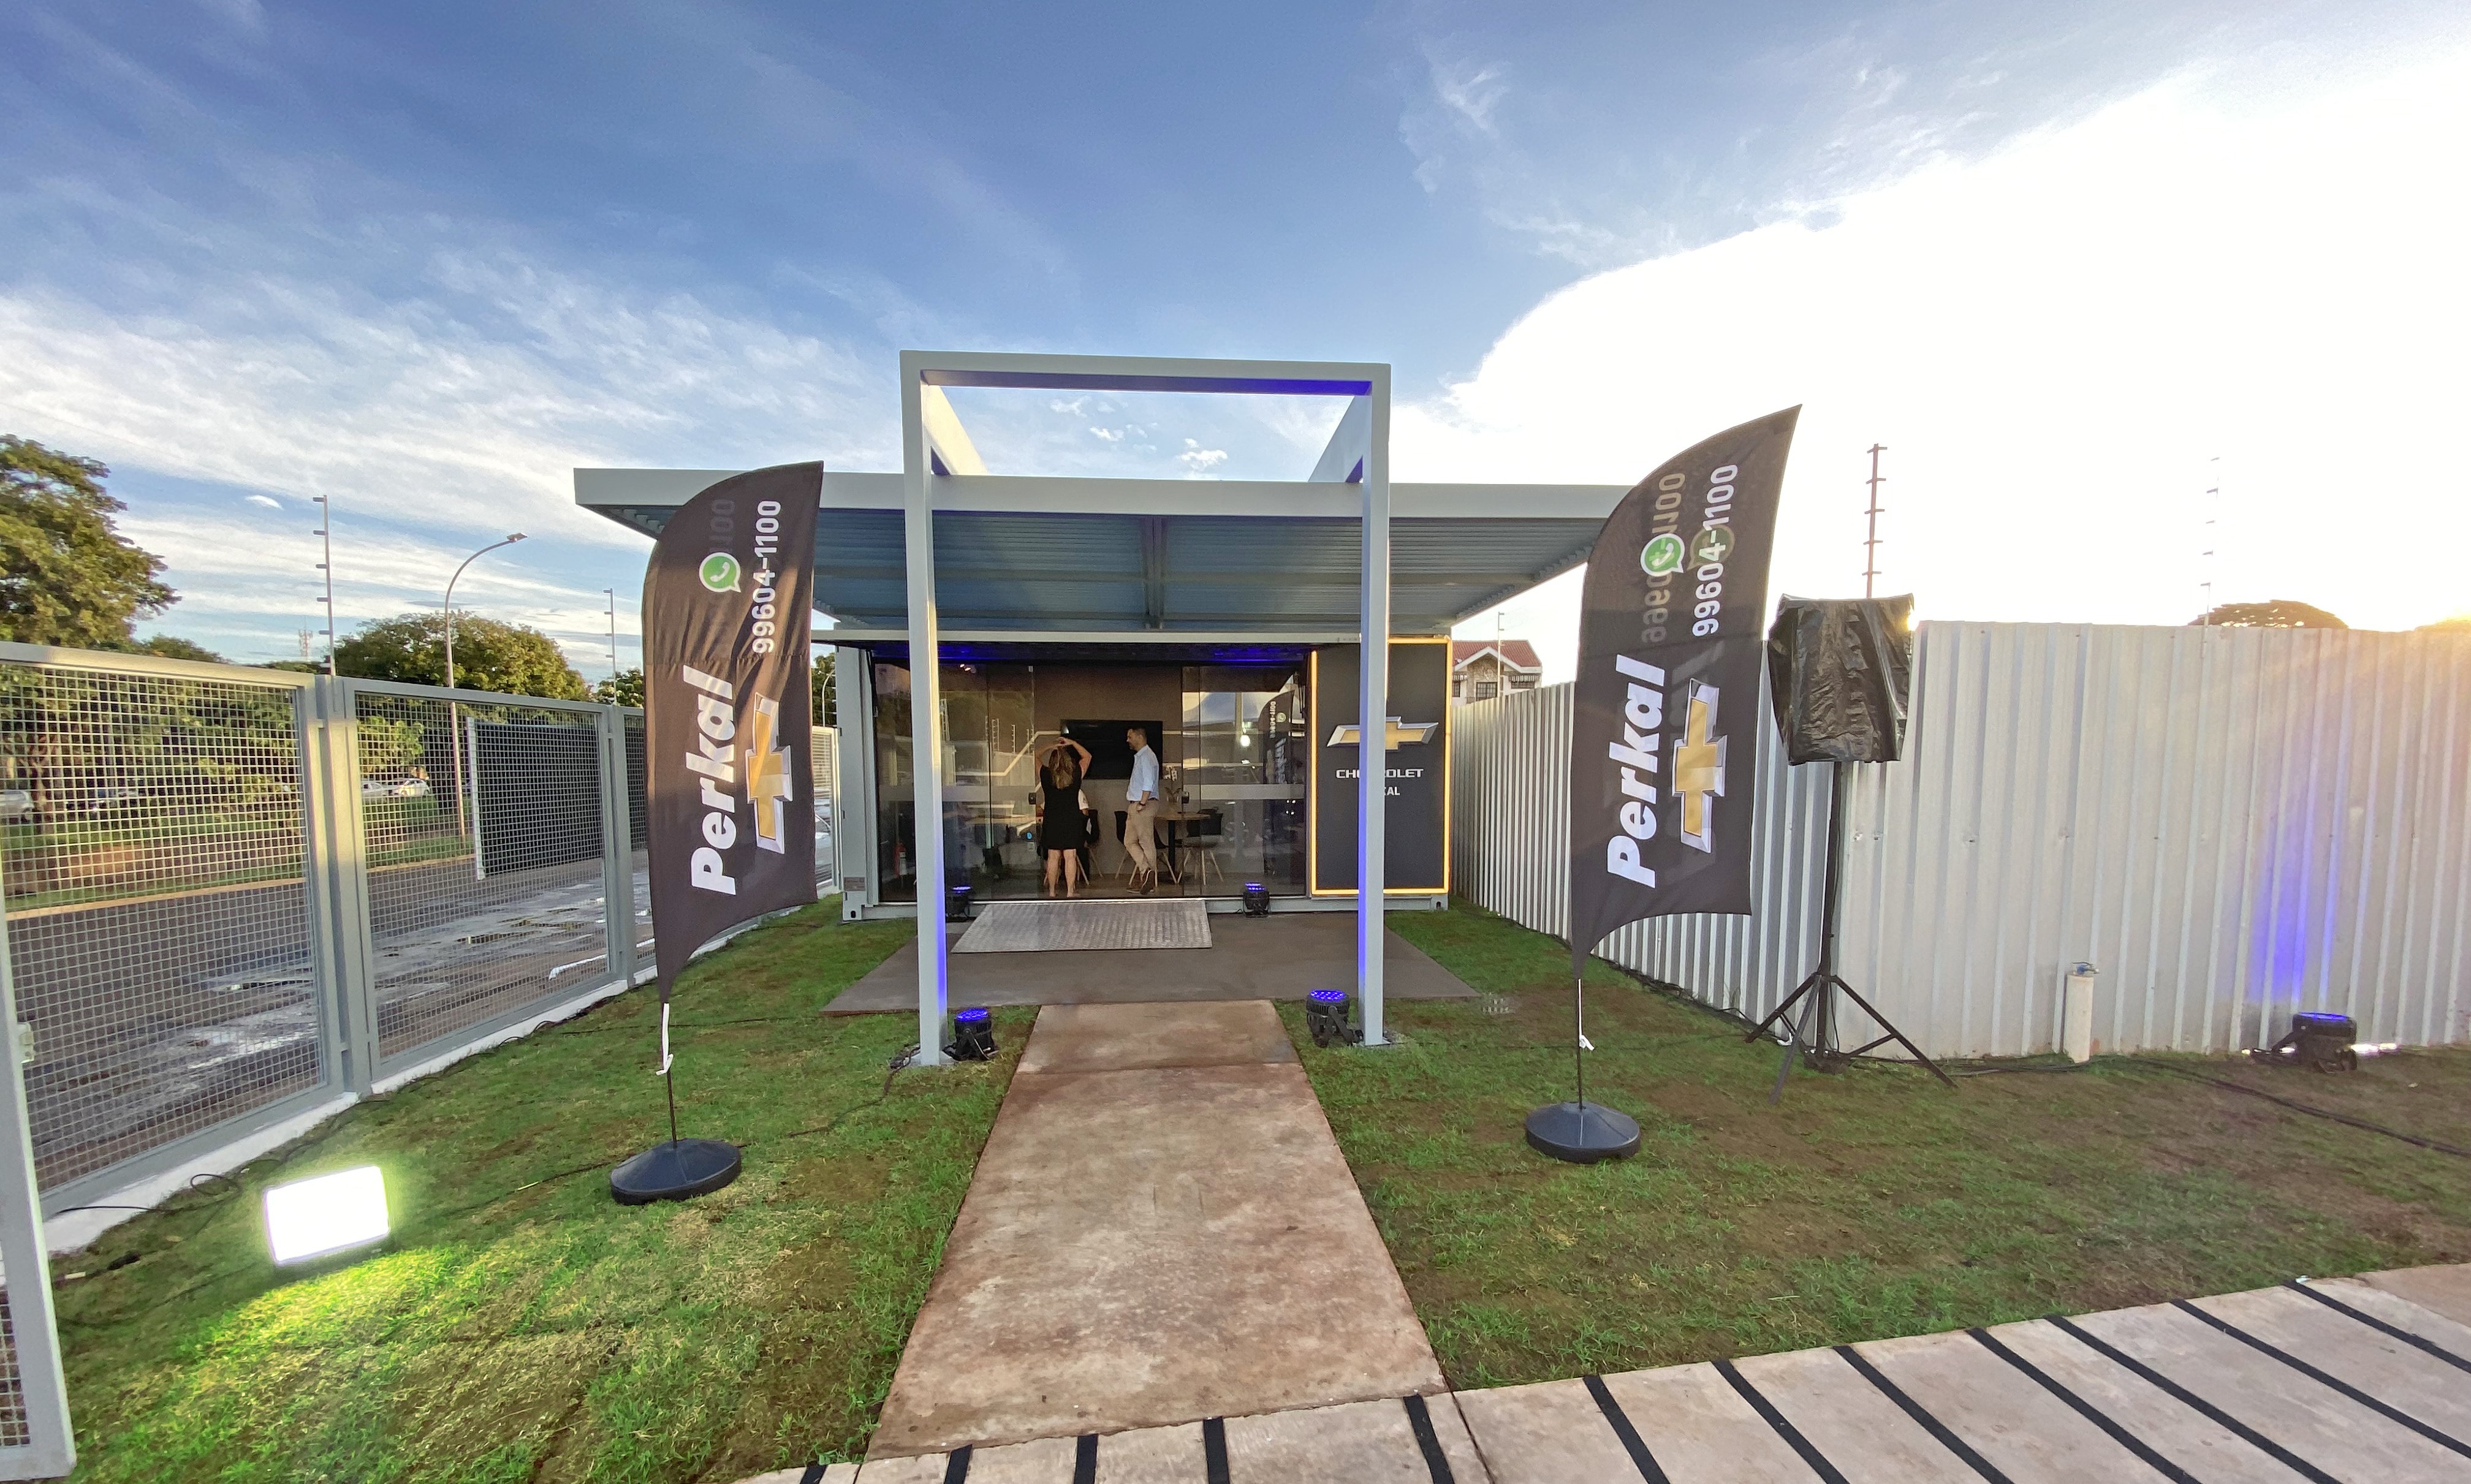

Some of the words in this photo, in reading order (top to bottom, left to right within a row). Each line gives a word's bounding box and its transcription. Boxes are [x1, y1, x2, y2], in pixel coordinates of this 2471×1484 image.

[752, 501, 781, 653] 99604-1100
[1692, 464, 1738, 637] 99604-1100
[683, 665, 737, 896] Perkal
[1336, 769, 1424, 778] CHOLET
[1607, 654, 1664, 888] Perkal
